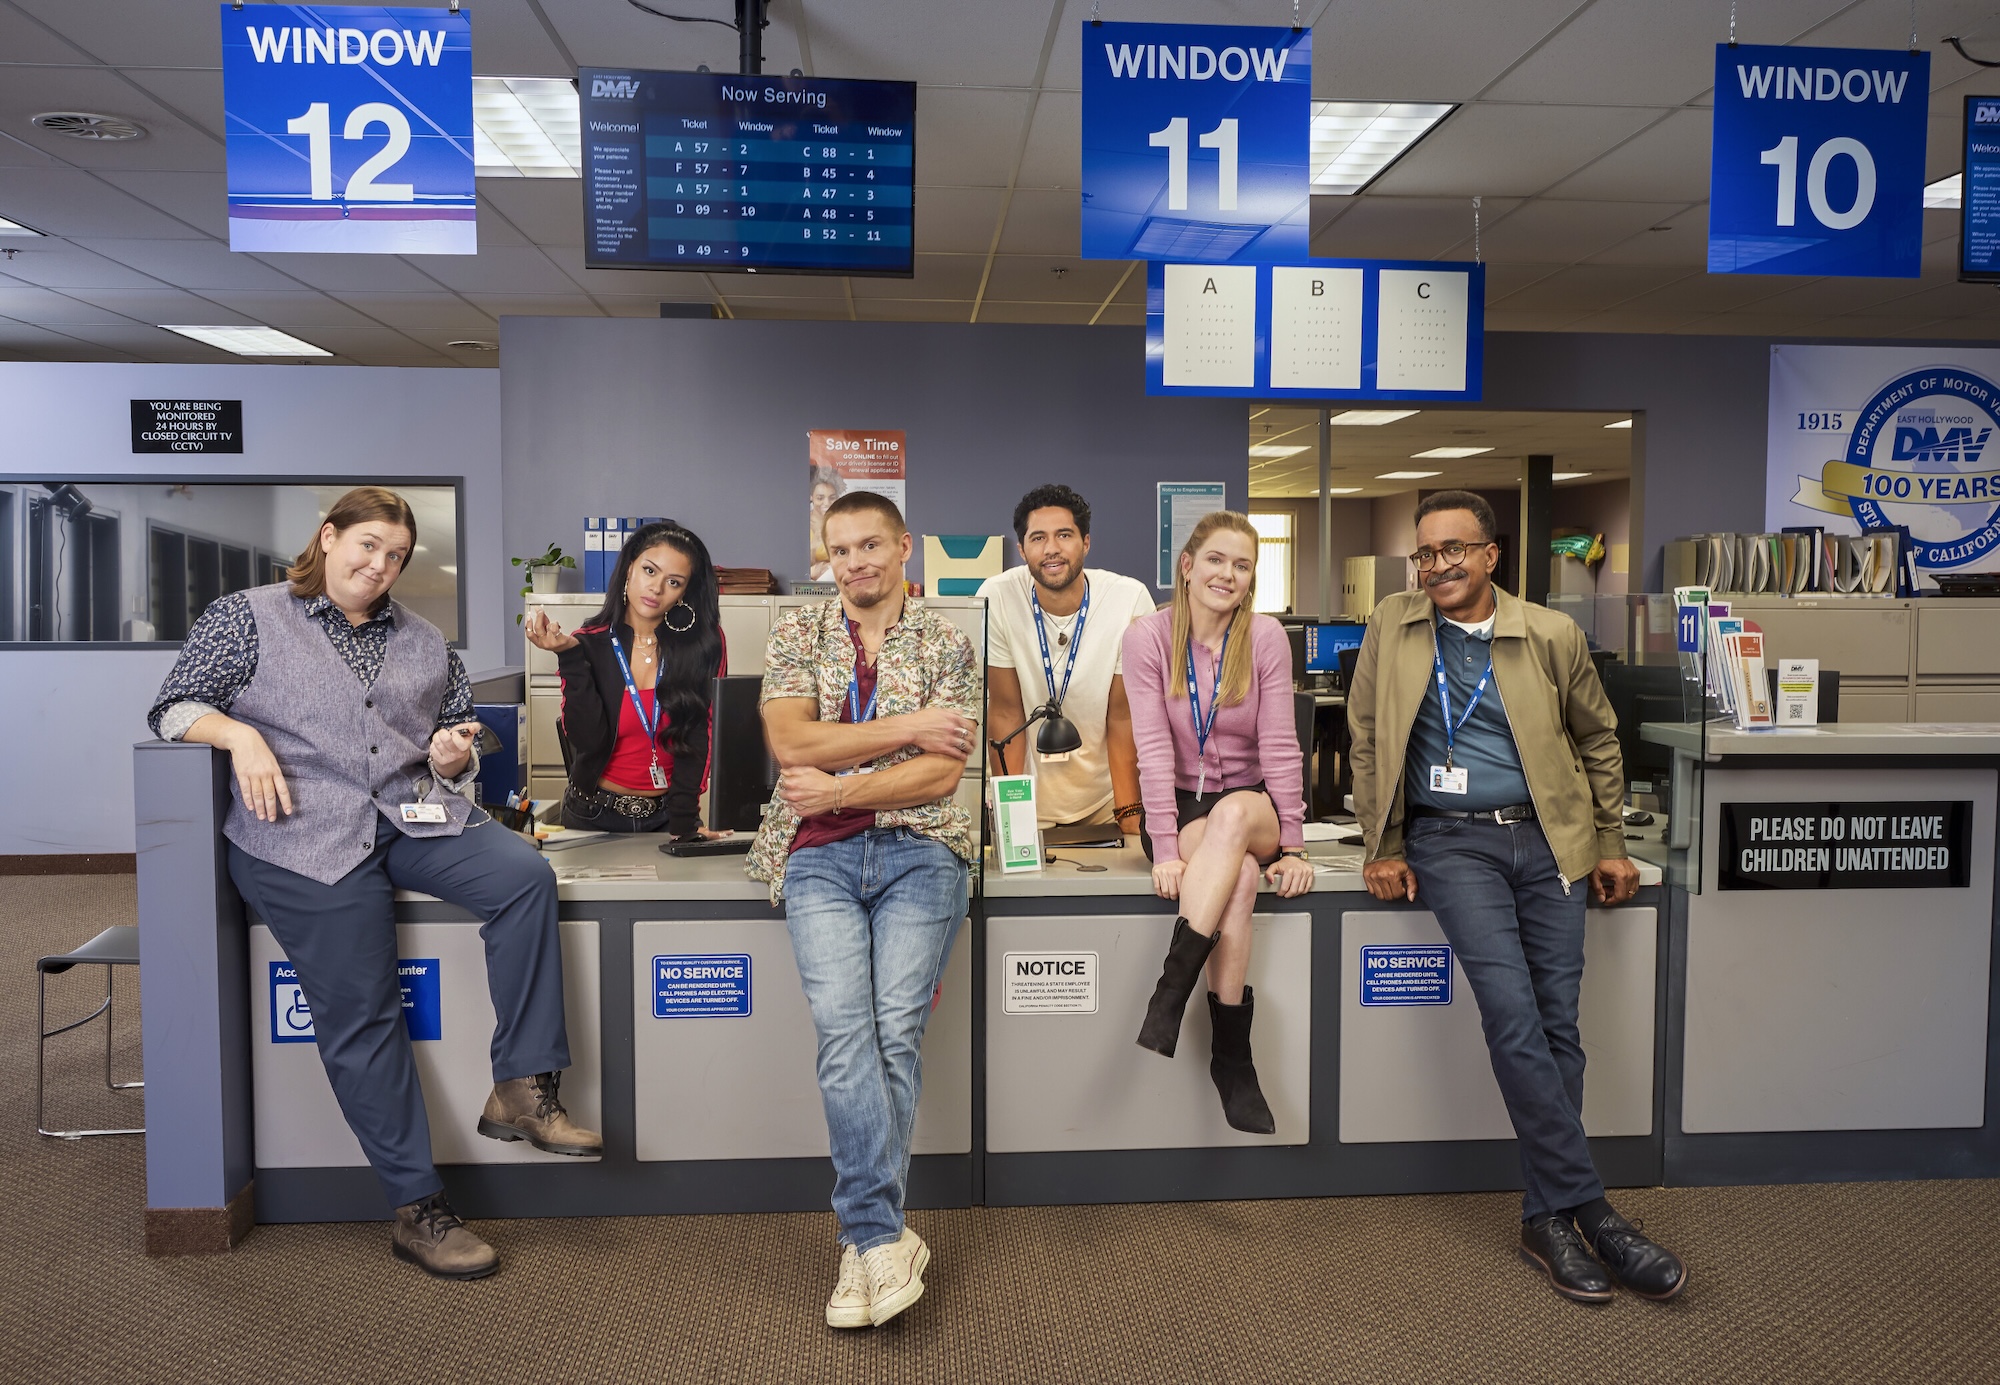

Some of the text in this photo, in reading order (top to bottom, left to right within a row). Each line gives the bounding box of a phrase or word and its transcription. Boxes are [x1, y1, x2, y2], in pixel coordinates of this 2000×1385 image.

[246, 26, 446, 67] WINDOW
[1105, 43, 1289, 82] WINDOW
[591, 80, 640, 99] DMV
[1737, 64, 1909, 104] WINDOW
[722, 86, 827, 108] Now Serving
[1975, 106, 2000, 123] DM
[589, 121, 640, 133] Welcome!
[681, 119, 774, 132] Ticket Window
[813, 124, 902, 137] Ticket Window
[287, 101, 414, 202] 12
[675, 142, 747, 154] A 57 2
[803, 147, 874, 160] C 88 1
[1972, 143, 2000, 153] Welco
[676, 163, 747, 175] F 57 7
[1149, 117, 1238, 211] 11
[804, 168, 874, 180] B 45 4
[676, 183, 748, 196] A 57 1
[1760, 136, 1877, 230] 10
[803, 188, 874, 200] A 47 3
[677, 204, 756, 216] D 09 10
[803, 208, 874, 220] A 48 5
[804, 228, 880, 241] B 52 11
[678, 245, 749, 256] B 49 9
[1203, 278, 1217, 294] A
[1312, 280, 1324, 296] B
[1418, 282, 1430, 299] C
[150, 402, 221, 411] YOU ARE BEING
[156, 412, 216, 420] MONITORED
[1798, 412, 1842, 430] 1915
[1856, 377, 1989, 456] DEPARTMENT OF MOTOR
[1918, 416, 1973, 424] HOLLYWOOD
[156, 422, 217, 430] 24 HOURS BY
[141, 432, 232, 440] CLOSED CIRCUIT TV
[171, 442, 203, 451] (CCTV)
[826, 438, 899, 451] Save Time
[1891, 427, 1993, 462] DMV
[1862, 473, 2000, 499] 100 YEARS
[1858, 501, 1882, 528] STA
[1928, 519, 2000, 563] CALIFORN
[1682, 615, 1695, 643] 11
[1750, 816, 1943, 842] PLEASE DO NOT LEAVE
[1741, 847, 1949, 873] CHILDREN UNATTENDED
[1017, 961, 1085, 976] NOTICE
[1368, 957, 1445, 969] NO SERVICE
[398, 966, 427, 976] unter
[660, 967, 743, 979] NO SERVICE
